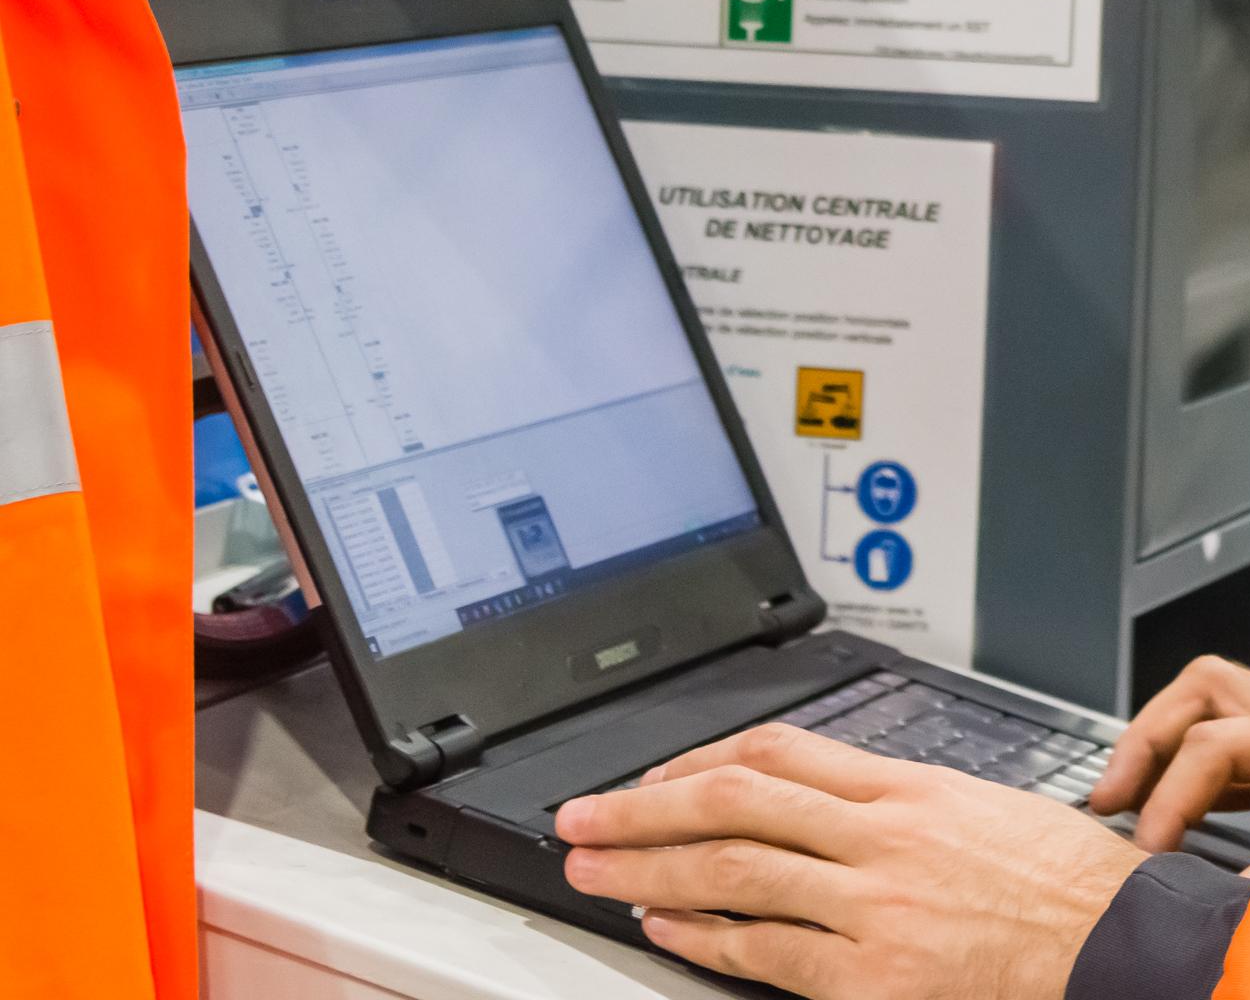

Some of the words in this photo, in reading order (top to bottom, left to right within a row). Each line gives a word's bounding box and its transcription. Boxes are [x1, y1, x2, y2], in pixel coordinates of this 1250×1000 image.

[659, 185, 806, 213] UTILISATION
[811, 196, 942, 223] CENTRALE
[704, 217, 737, 239] DE
[743, 221, 891, 249] NETTOYAGE
